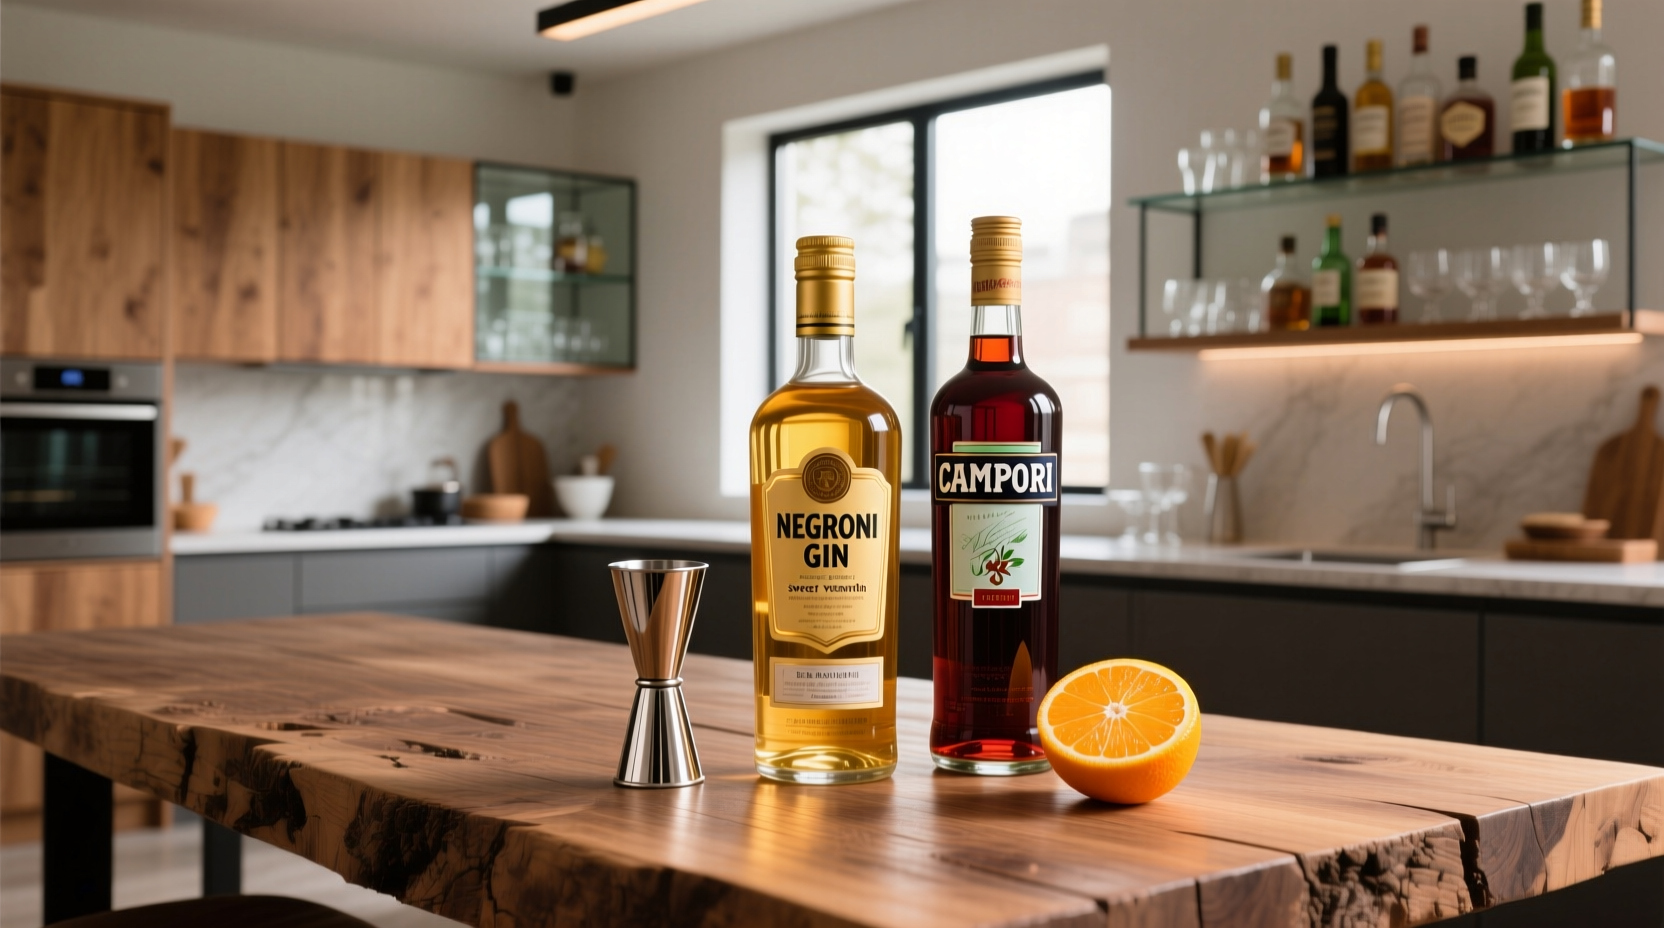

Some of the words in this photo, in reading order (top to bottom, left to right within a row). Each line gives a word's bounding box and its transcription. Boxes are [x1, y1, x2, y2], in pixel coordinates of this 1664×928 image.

[939, 462, 1053, 493] CAMPORI
[777, 513, 878, 539] NEGRONI
[803, 543, 849, 569] GIN
